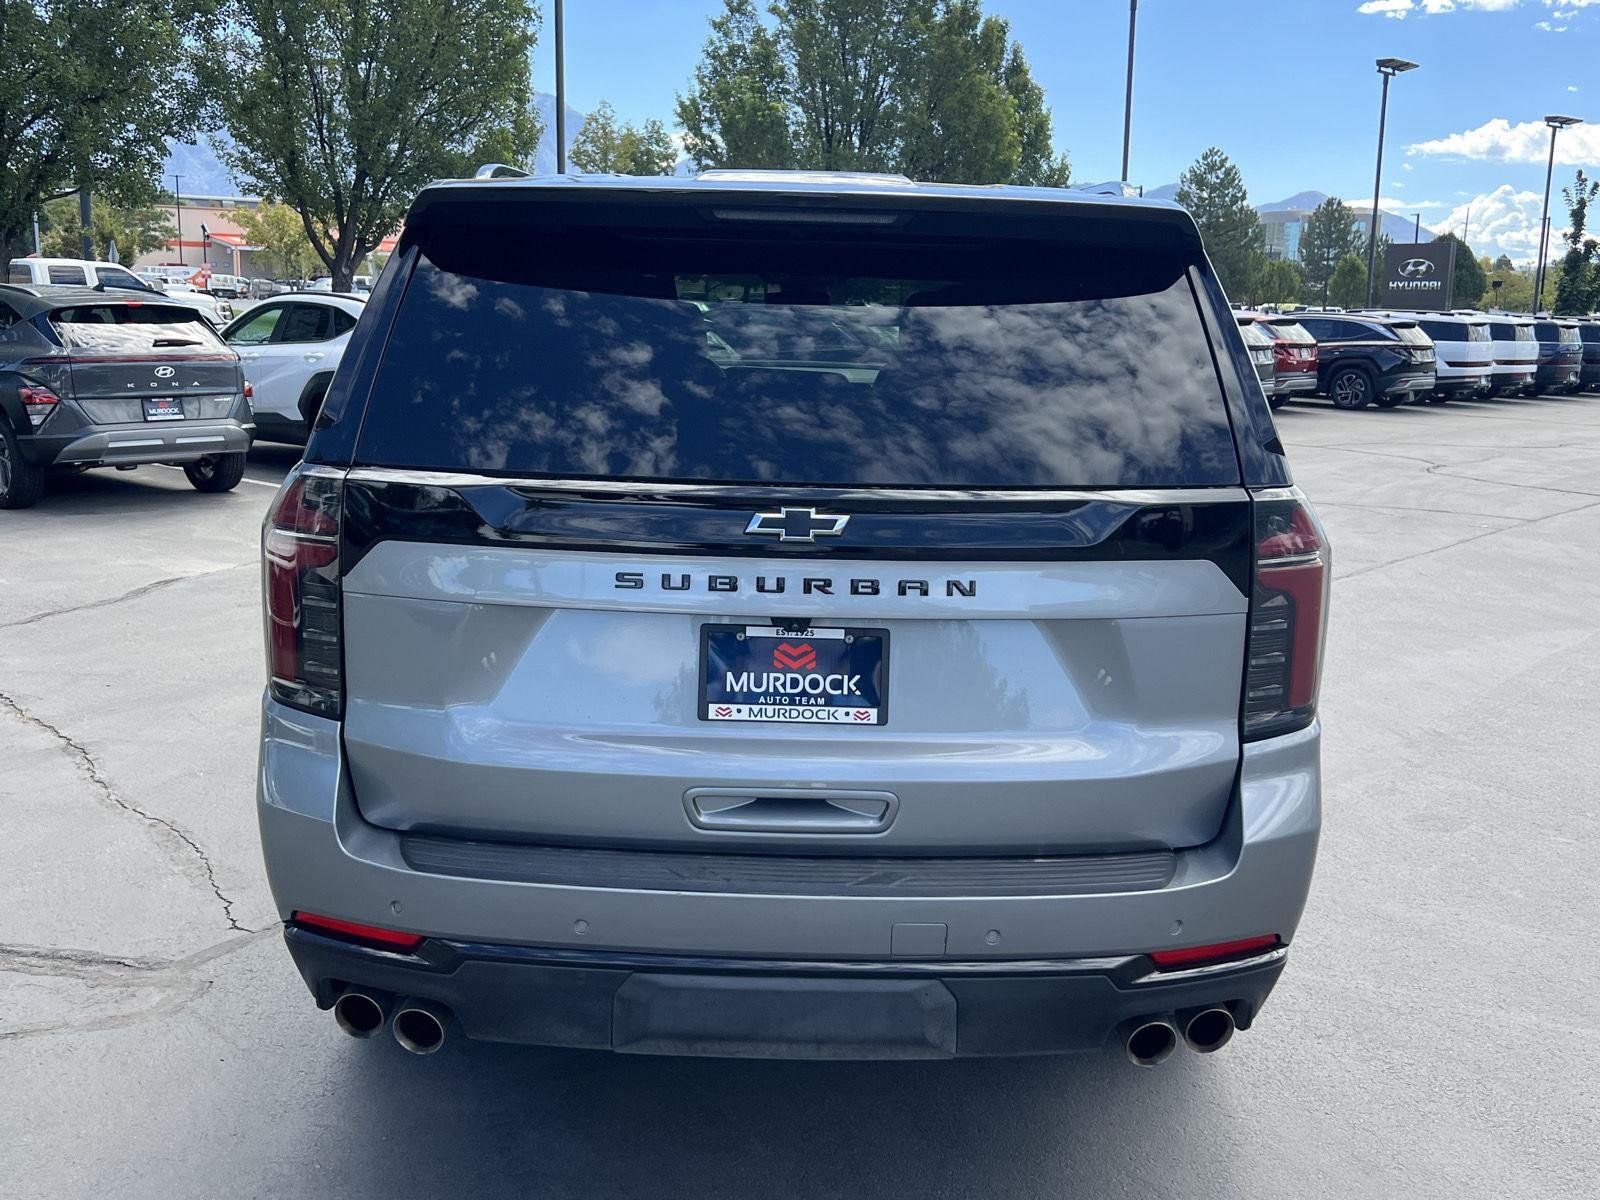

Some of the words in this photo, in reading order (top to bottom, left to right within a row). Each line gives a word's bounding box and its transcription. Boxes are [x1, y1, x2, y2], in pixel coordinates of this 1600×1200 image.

[1389, 281, 1441, 290] HYUNDAI
[614, 572, 976, 597] SUBURBAN
[726, 672, 861, 695] MURDOCK
[759, 696, 789, 704] AUTO
[795, 697, 825, 705] TEAM
[748, 707, 839, 720] MURDOCK
